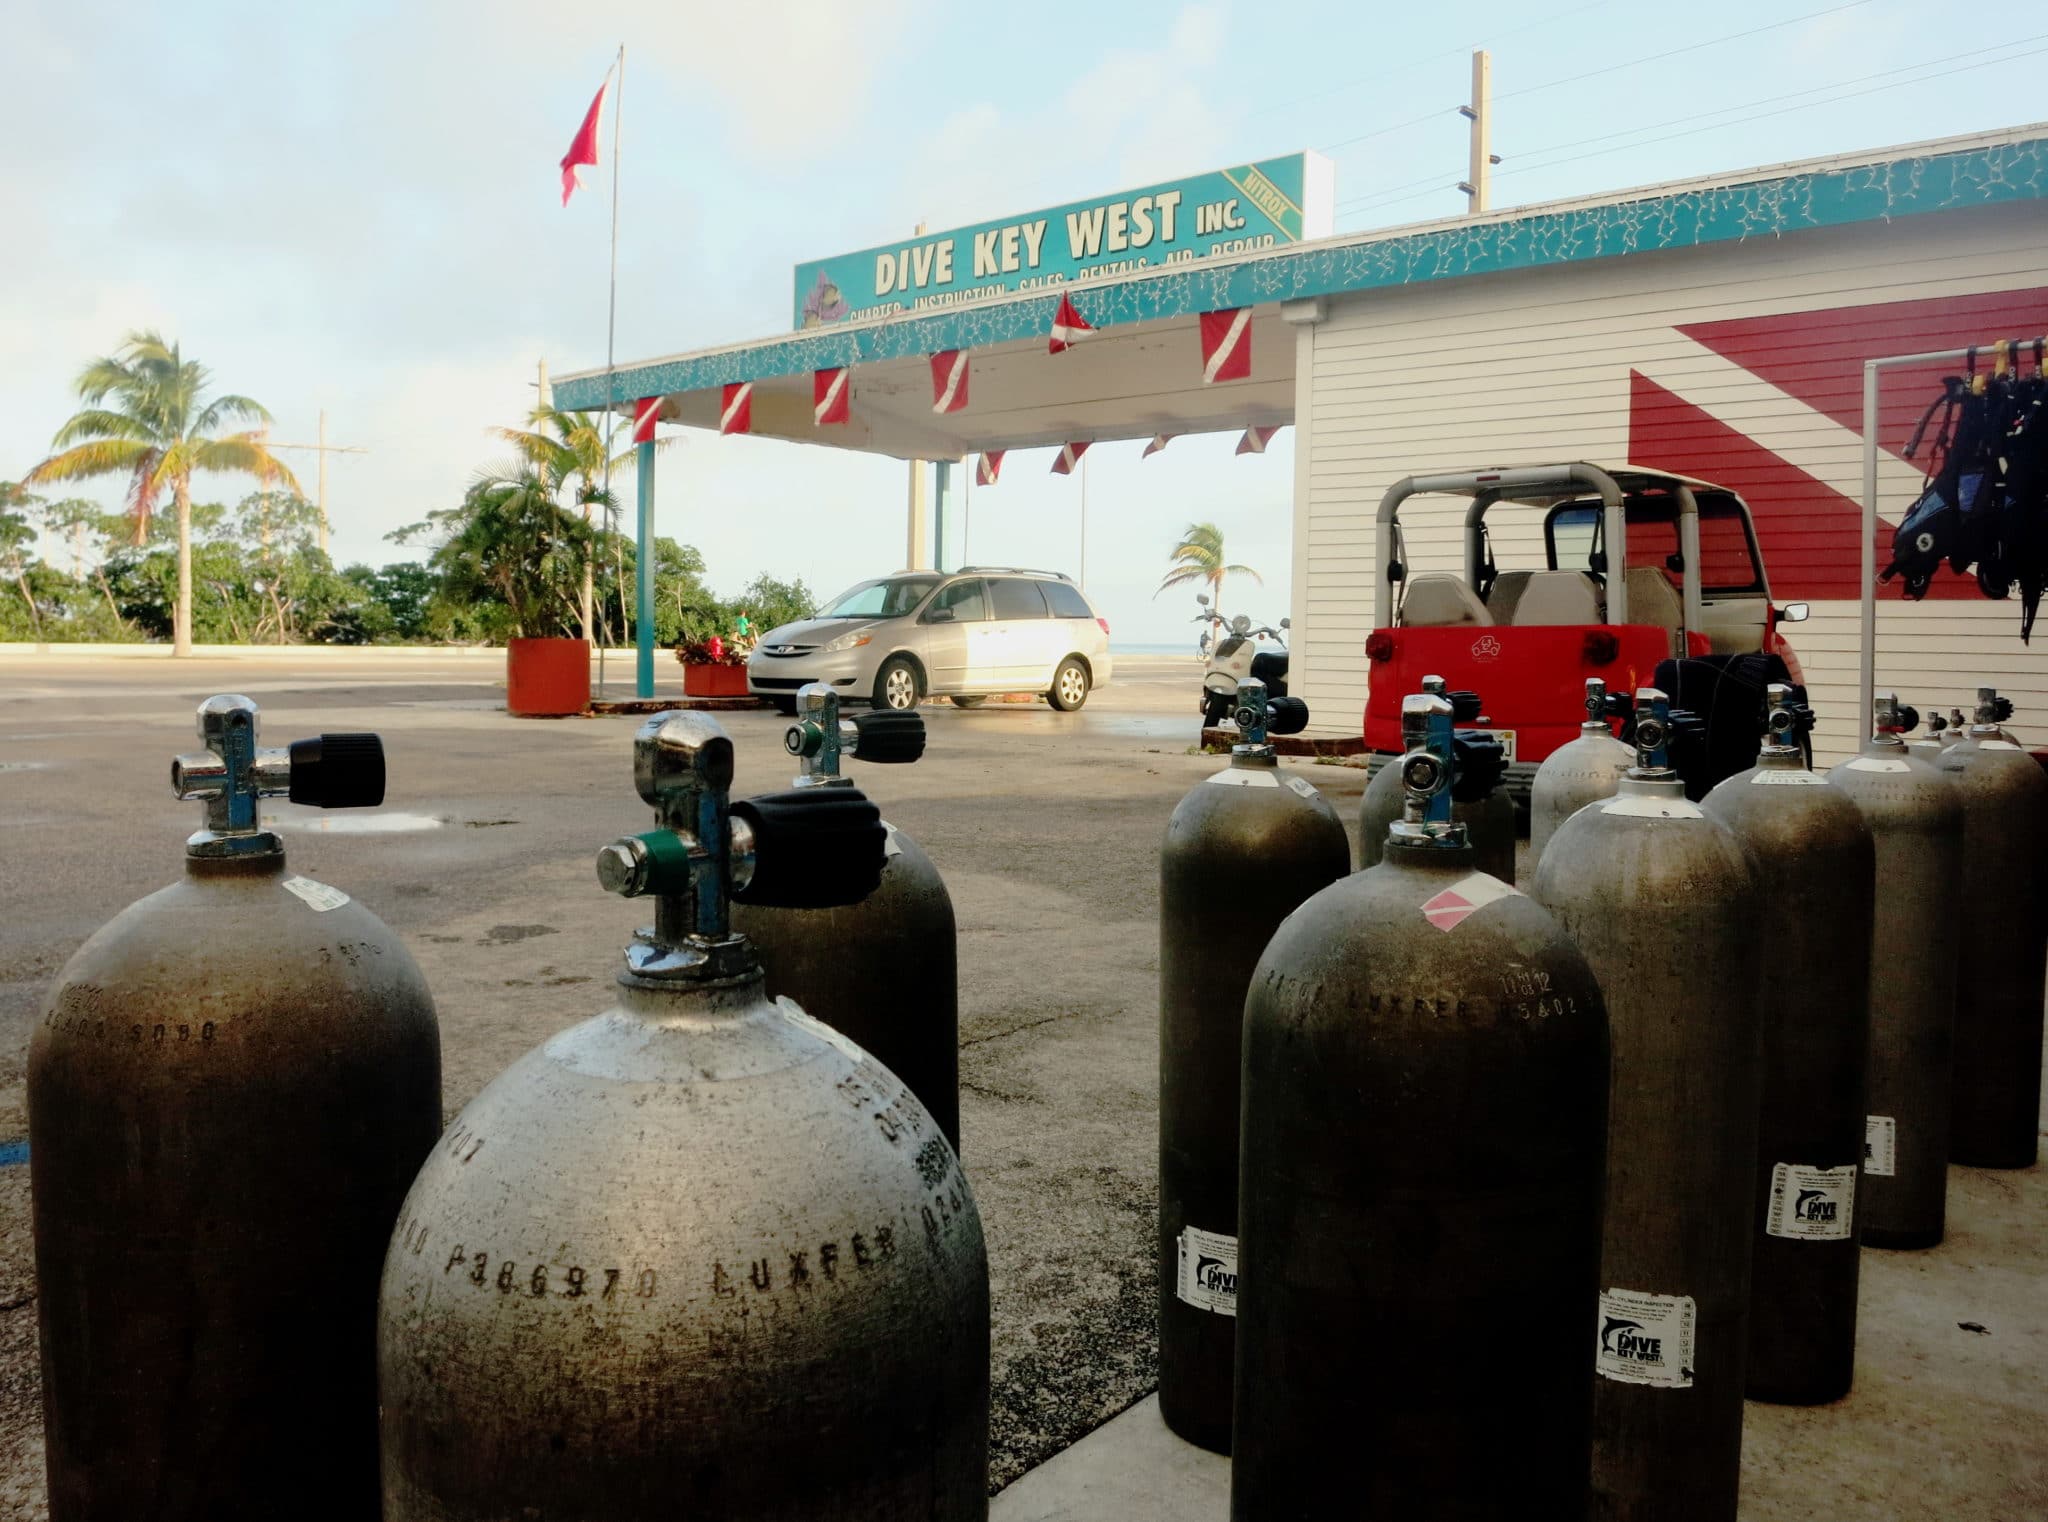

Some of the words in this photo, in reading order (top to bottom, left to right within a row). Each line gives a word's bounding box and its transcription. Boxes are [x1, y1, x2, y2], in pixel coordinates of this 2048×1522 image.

[1242, 175, 1289, 221] NITROX
[875, 239, 955, 297] DIVE
[973, 219, 1048, 280] KEY
[1066, 190, 1182, 260] WEST
[1196, 199, 1246, 236] INC.
[1807, 1202, 1837, 1215] DIVE
[1617, 1333, 1661, 1354] DIVE
